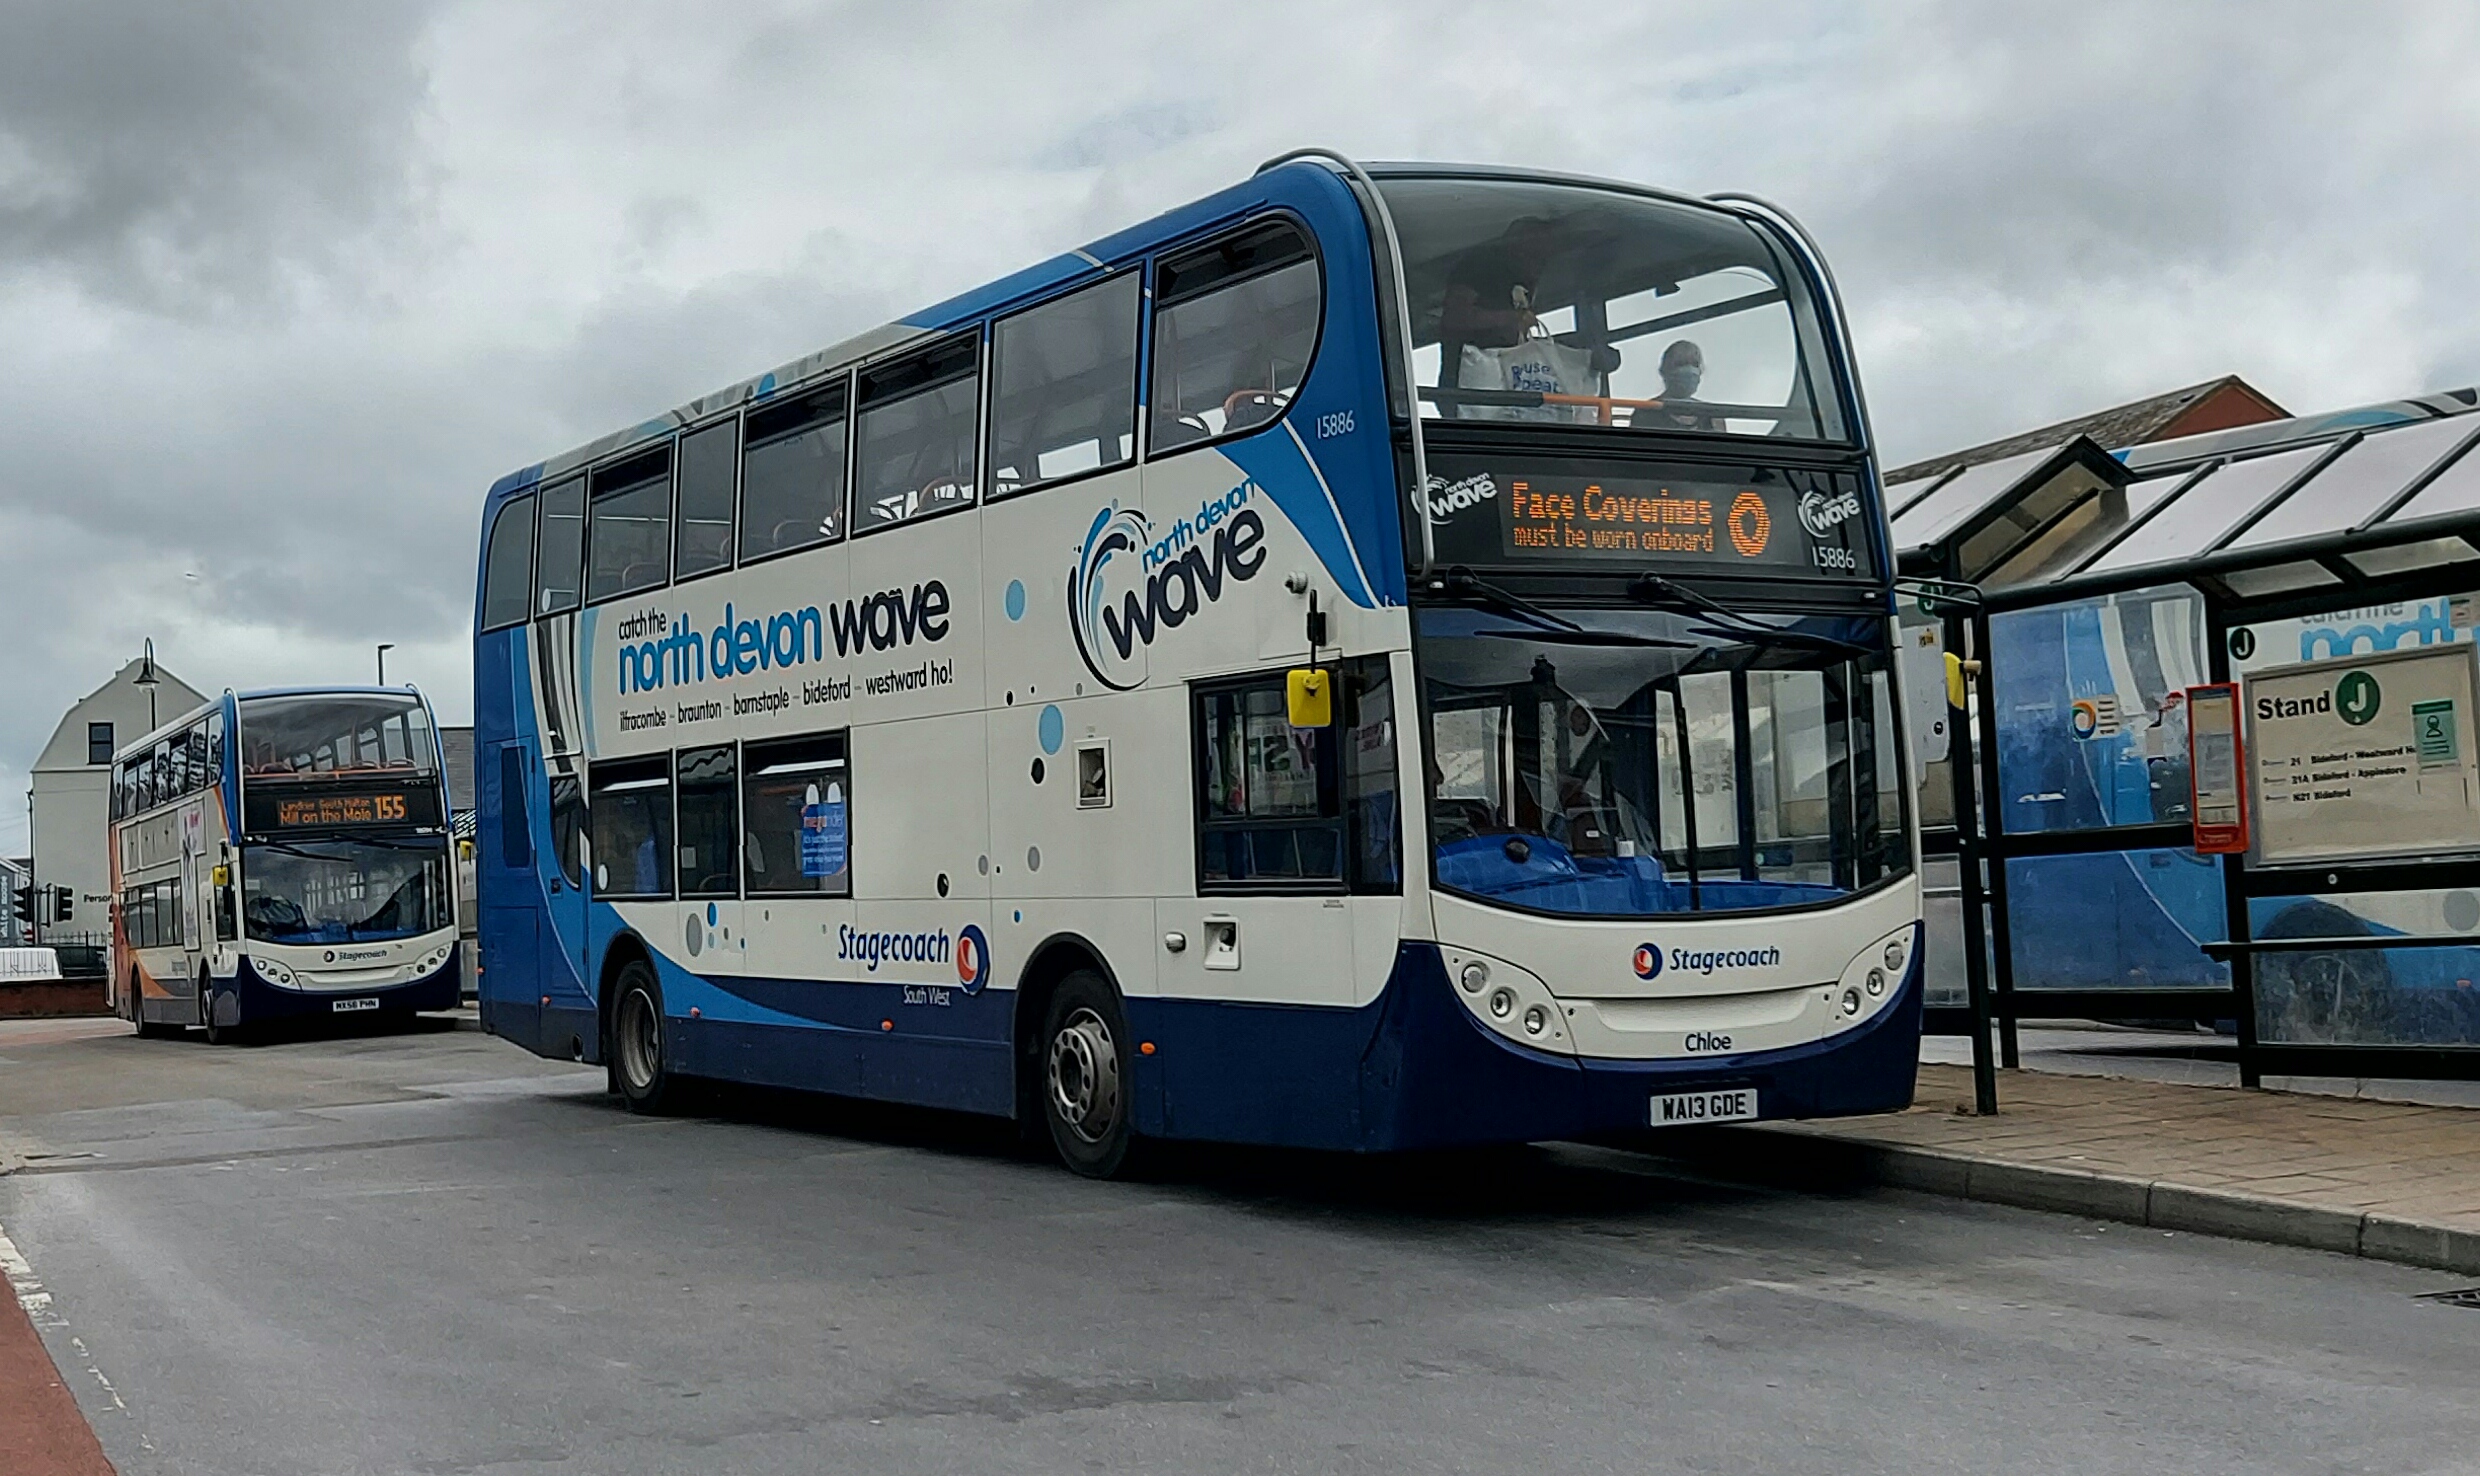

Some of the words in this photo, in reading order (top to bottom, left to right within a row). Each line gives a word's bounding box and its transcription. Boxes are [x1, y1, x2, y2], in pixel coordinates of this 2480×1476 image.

[1316, 409, 1355, 440] 15886
[1428, 479, 1498, 517] wave
[1512, 481, 1576, 520] Face
[1142, 518, 1194, 574] north
[1196, 476, 1256, 535] devon
[1811, 498, 1860, 531] wave
[1513, 522, 1560, 547] must
[1564, 522, 1587, 548] be
[1591, 530, 1637, 550] worn
[1643, 526, 1714, 553] onboard
[1811, 545, 1856, 569] 15886
[1102, 508, 1267, 661] wave
[618, 610, 648, 641] catch
[648, 606, 667, 635] the
[619, 612, 704, 696] north
[710, 602, 822, 680] devon
[830, 580, 950, 658] wave
[678, 700, 722, 724] braunton
[733, 686, 790, 717] barnstaple
[803, 675, 851, 705] bideford
[866, 661, 927, 696] westward
[931, 658, 953, 686] ho!
[2257, 690, 2331, 721] Stand
[302, 813, 319, 824] on
[321, 808, 341, 823] the
[375, 795, 405, 820] 155
[338, 949, 388, 961] Stagecoach
[837, 922, 950, 972] Stagecoach
[1669, 945, 1781, 976] Stagecoach
[903, 984, 928, 1005] South
[928, 986, 951, 1007] West
[1684, 1031, 1732, 1052] Chloe
[1662, 1096, 1705, 1120] WA13
[1710, 1092, 1748, 1117] GDE
